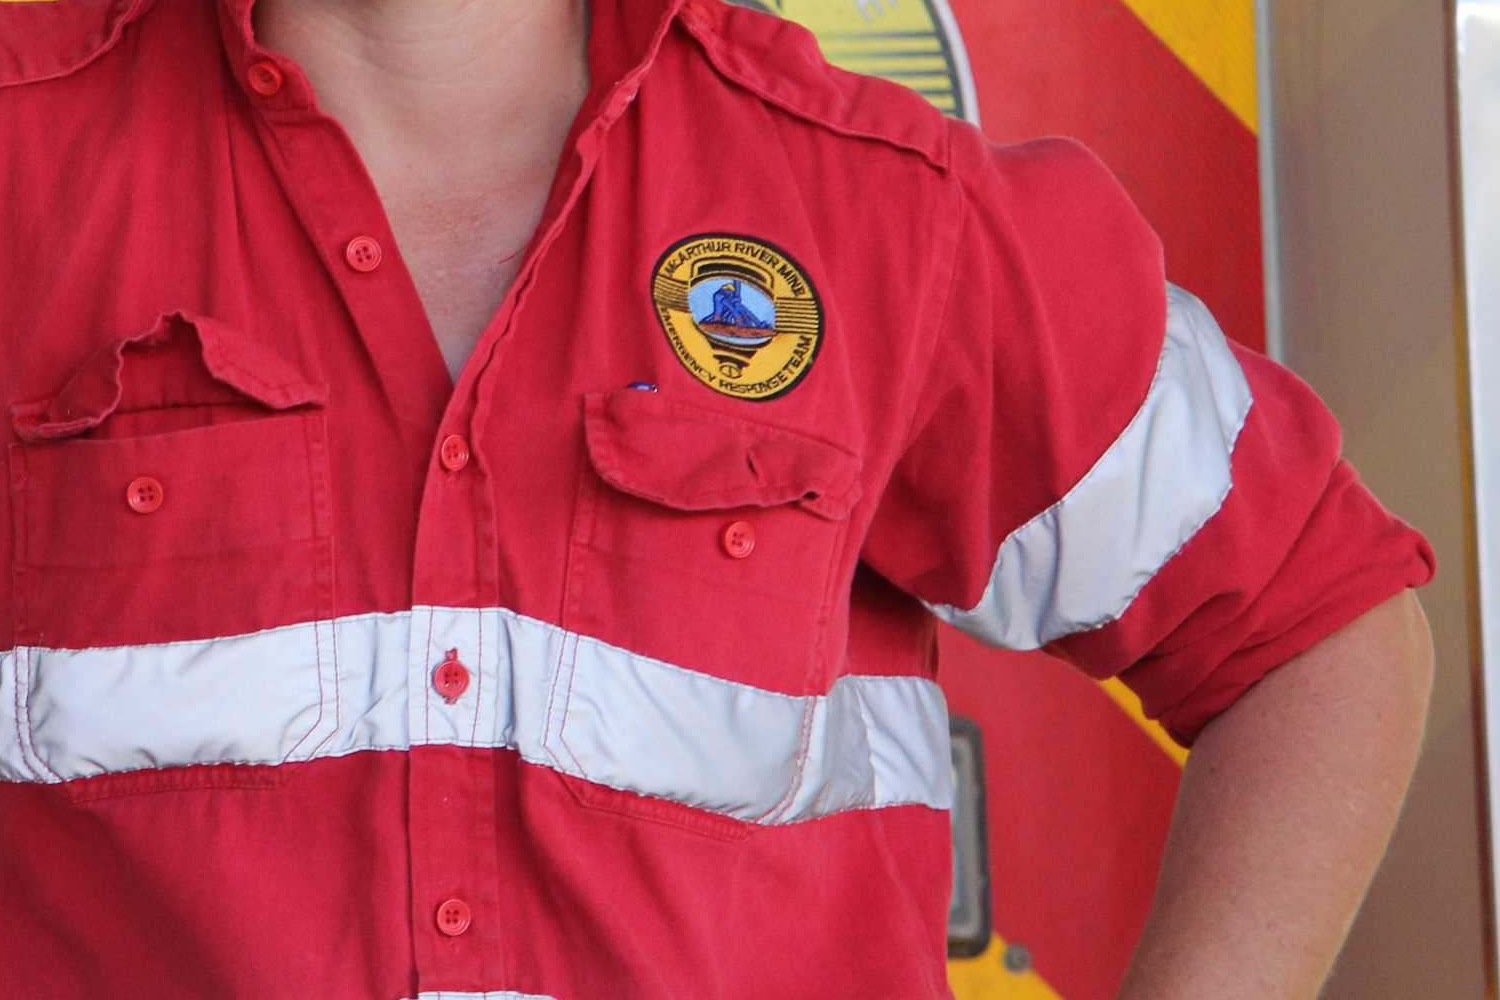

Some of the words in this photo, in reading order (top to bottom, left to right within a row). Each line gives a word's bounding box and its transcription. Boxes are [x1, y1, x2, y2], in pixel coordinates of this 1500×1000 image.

[734, 242, 780, 268] RIVER
[776, 264, 806, 297] MINE
[782, 334, 813, 374] TEAM
